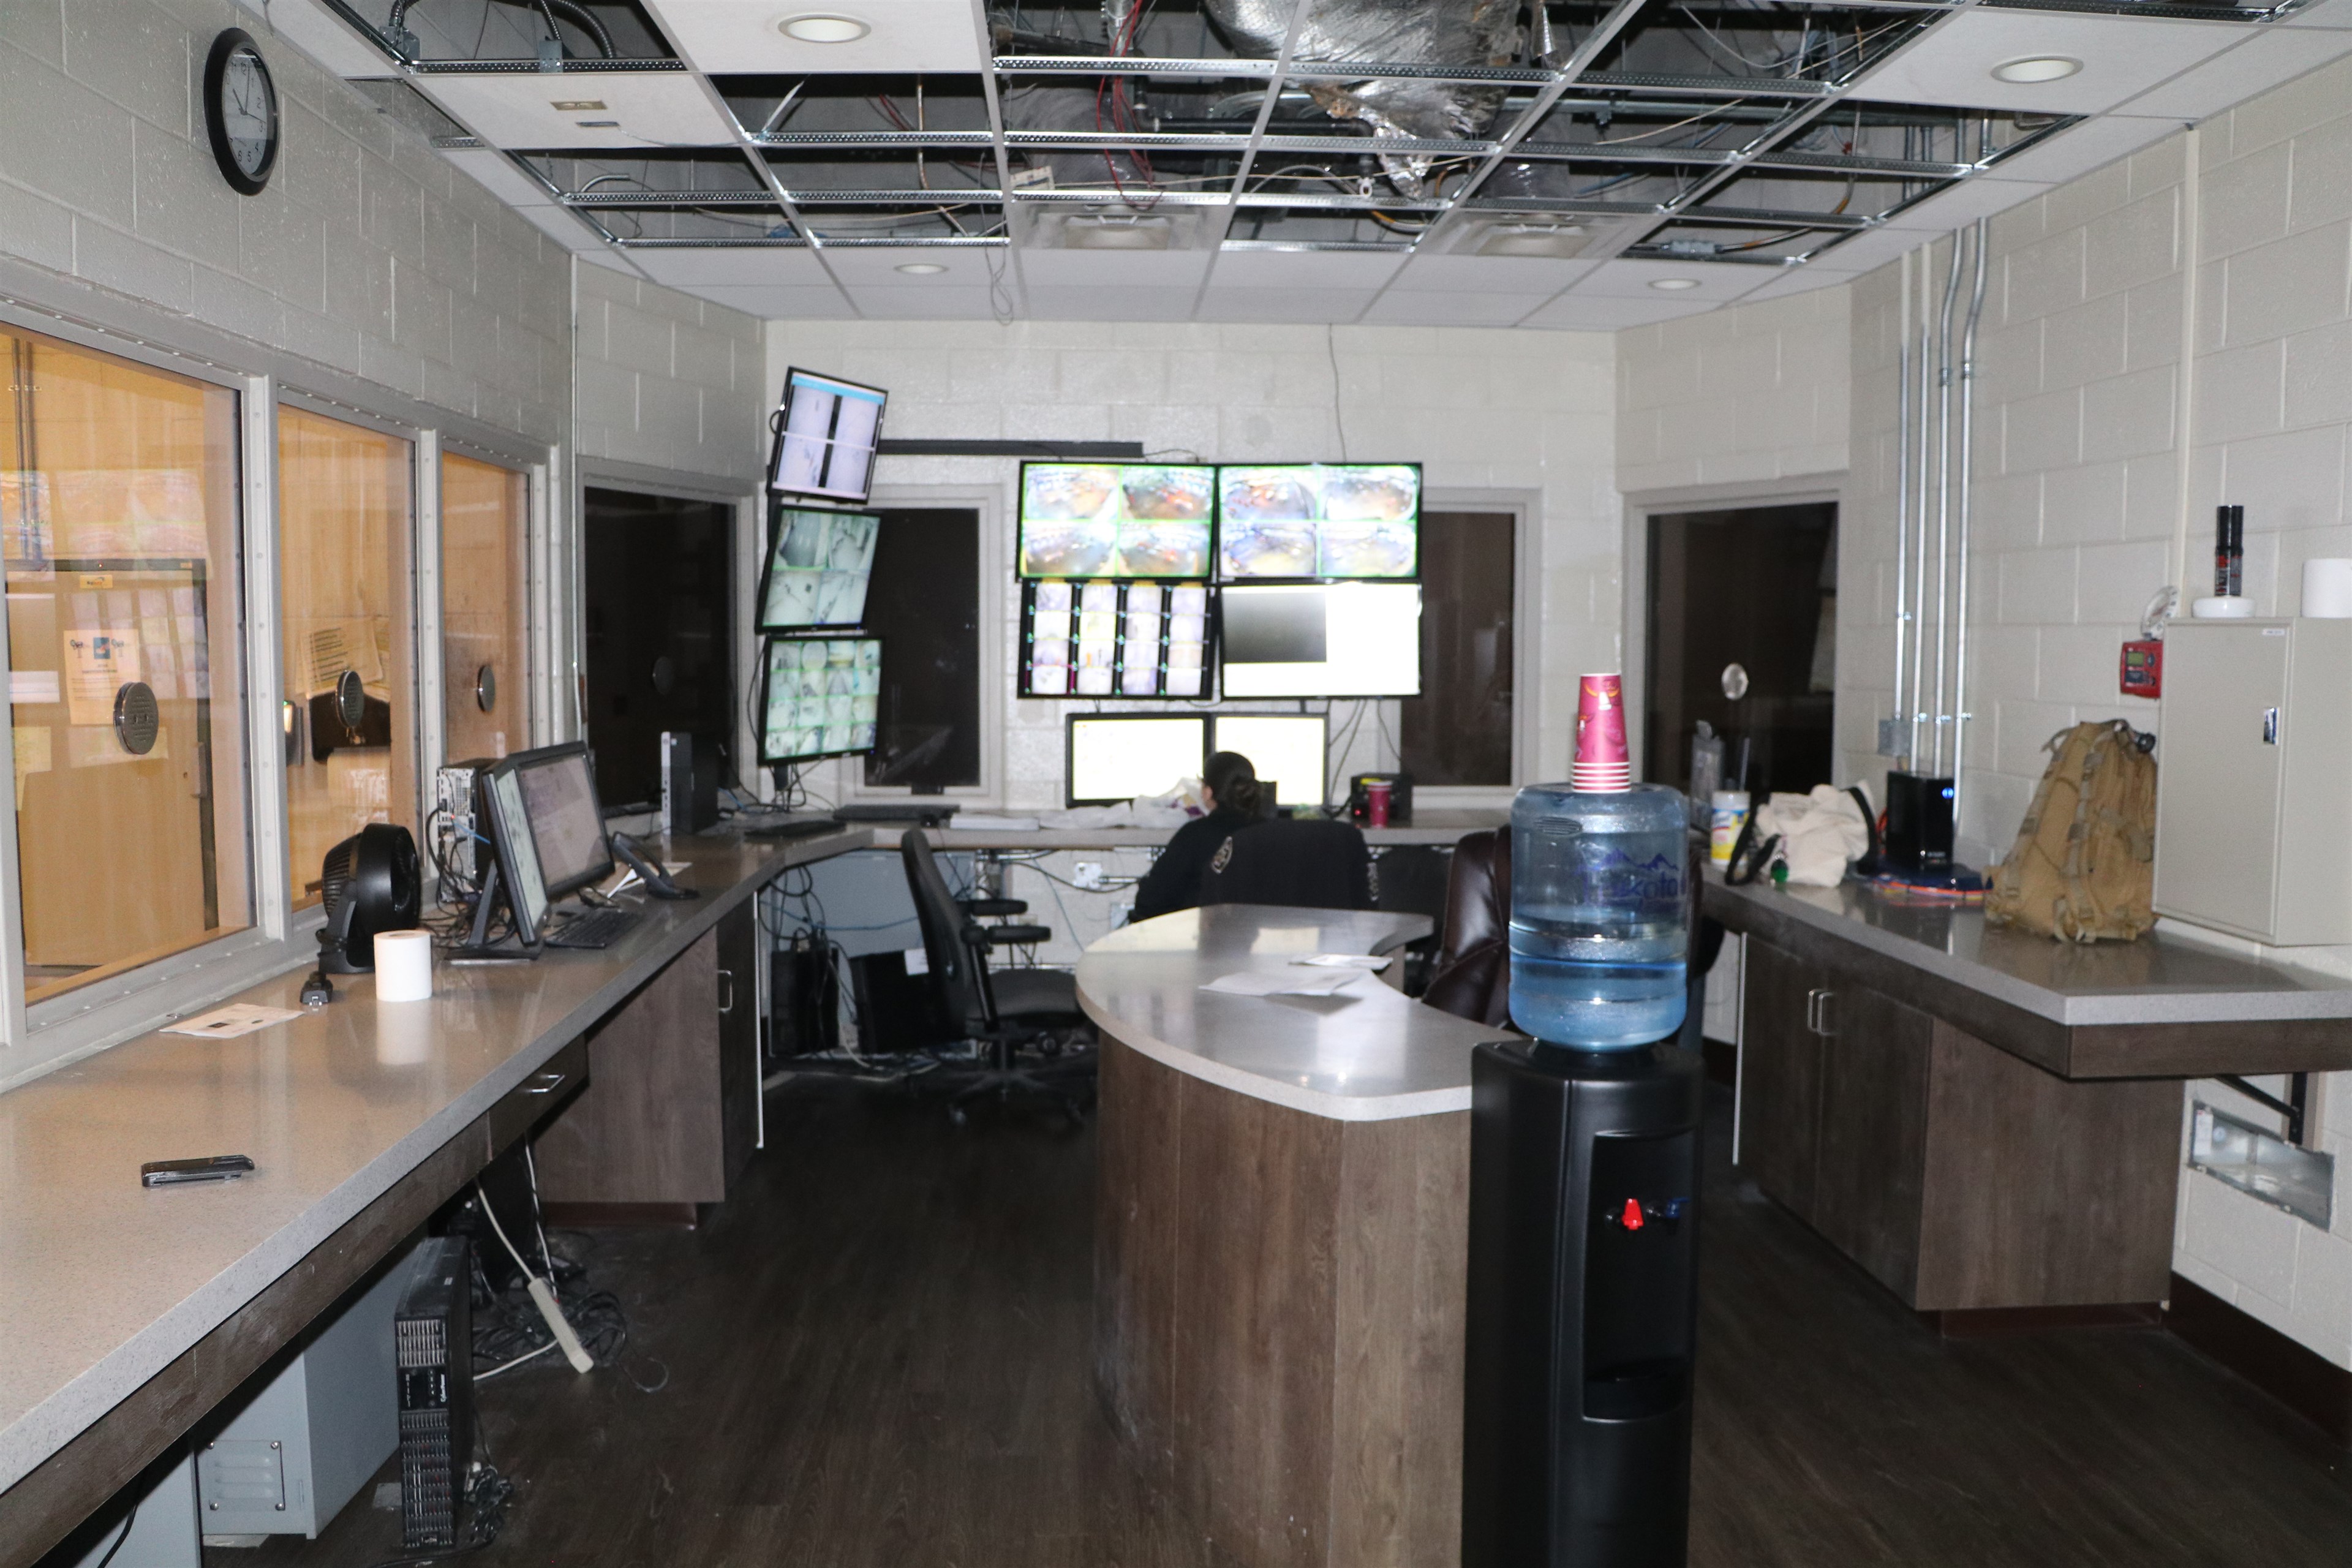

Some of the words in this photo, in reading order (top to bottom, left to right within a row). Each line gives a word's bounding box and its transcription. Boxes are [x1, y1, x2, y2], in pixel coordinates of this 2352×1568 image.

[241, 62, 246, 75] 12
[257, 97, 262, 109] 2
[259, 121, 263, 132] 3
[238, 150, 243, 162] 6
[247, 151, 252, 162] 5
